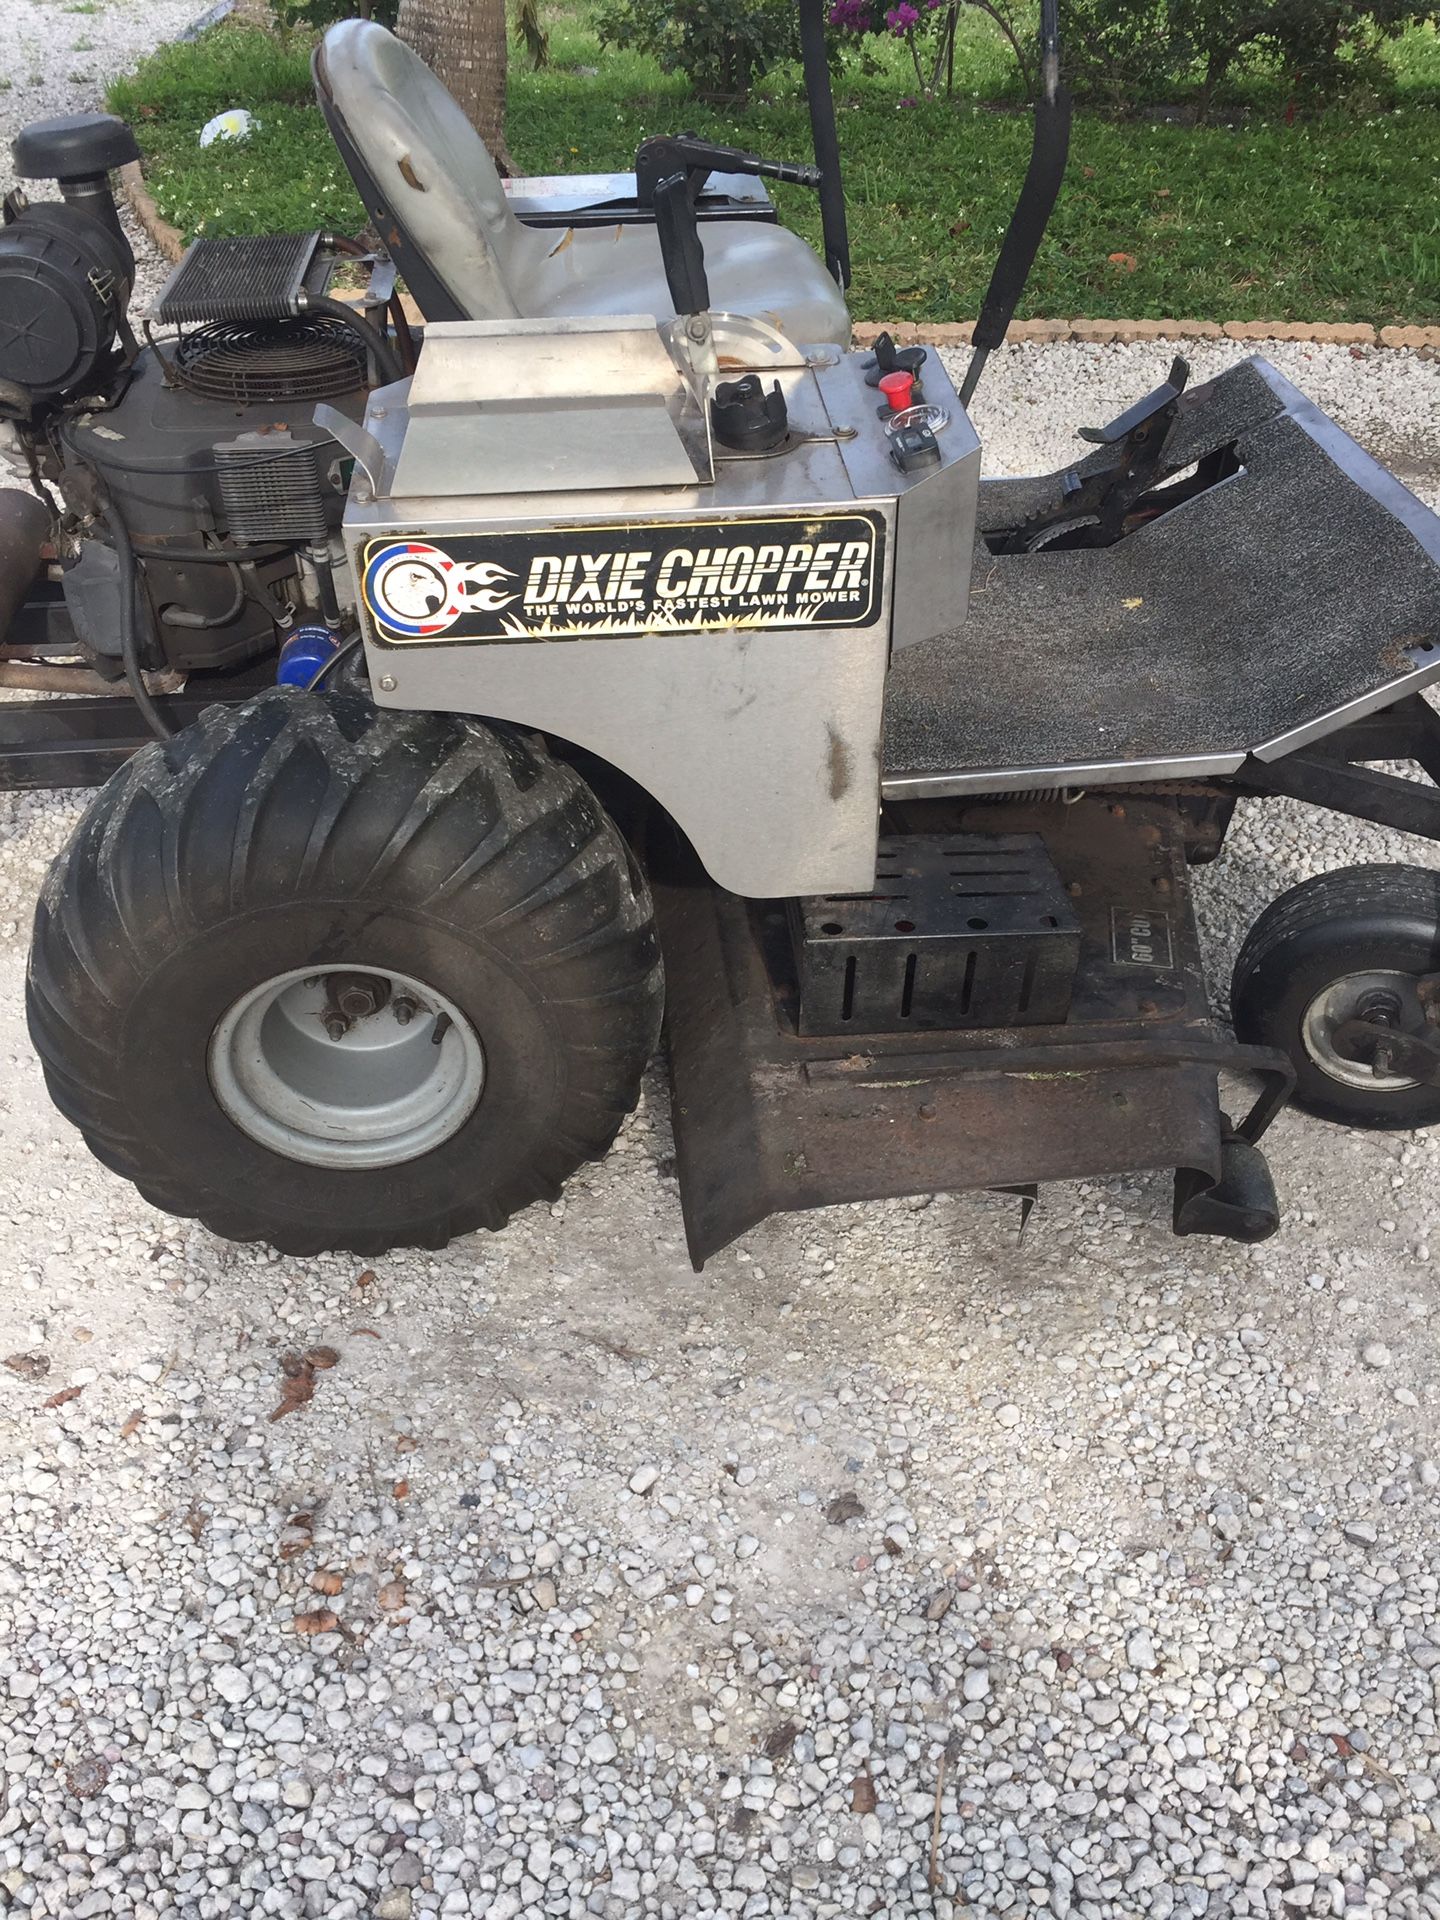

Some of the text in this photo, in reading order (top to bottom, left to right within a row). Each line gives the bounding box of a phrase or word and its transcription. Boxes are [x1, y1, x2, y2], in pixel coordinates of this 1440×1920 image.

[523, 552, 652, 604] DIXIE
[523, 590, 861, 617] THE WORLD'S FASTEST LAWN MOWER
